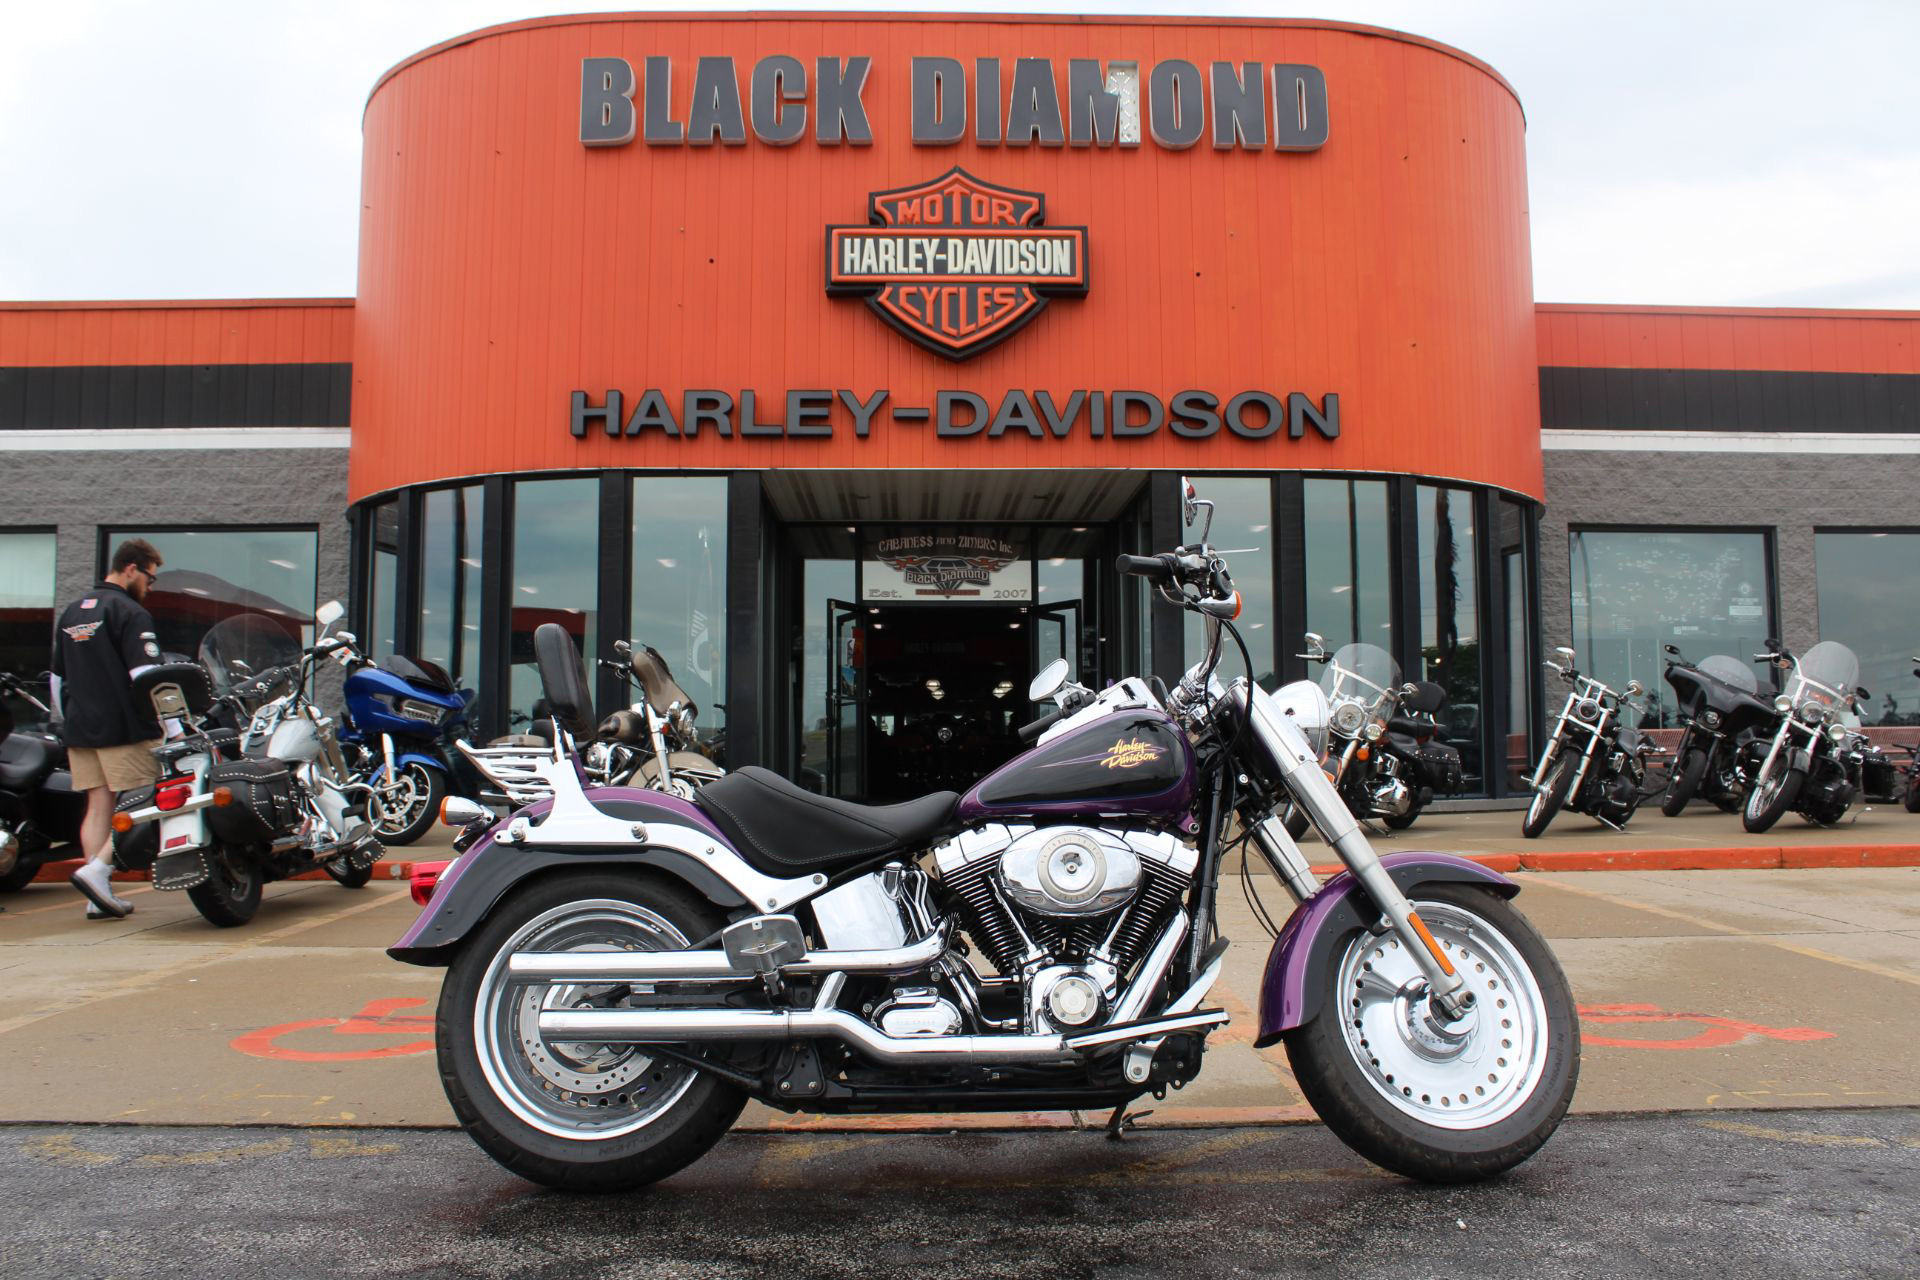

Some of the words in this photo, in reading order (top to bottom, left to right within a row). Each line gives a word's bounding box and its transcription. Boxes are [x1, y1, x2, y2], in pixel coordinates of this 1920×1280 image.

[580, 55, 873, 147] BLACK
[911, 56, 1329, 151] DIAMOND
[897, 183, 1015, 225] MOTOR
[843, 237, 1071, 275] HARLEY-DAVIDSON
[899, 286, 1017, 336] CYCLES
[571, 389, 1340, 440] HARLEY-DAVIDSON
[878, 535, 934, 552] CABANESS
[958, 535, 998, 551] ZIMBRO
[868, 589, 902, 598] Est.
[993, 589, 1028, 599] 2007
[1100, 749, 1160, 769] Davidson
